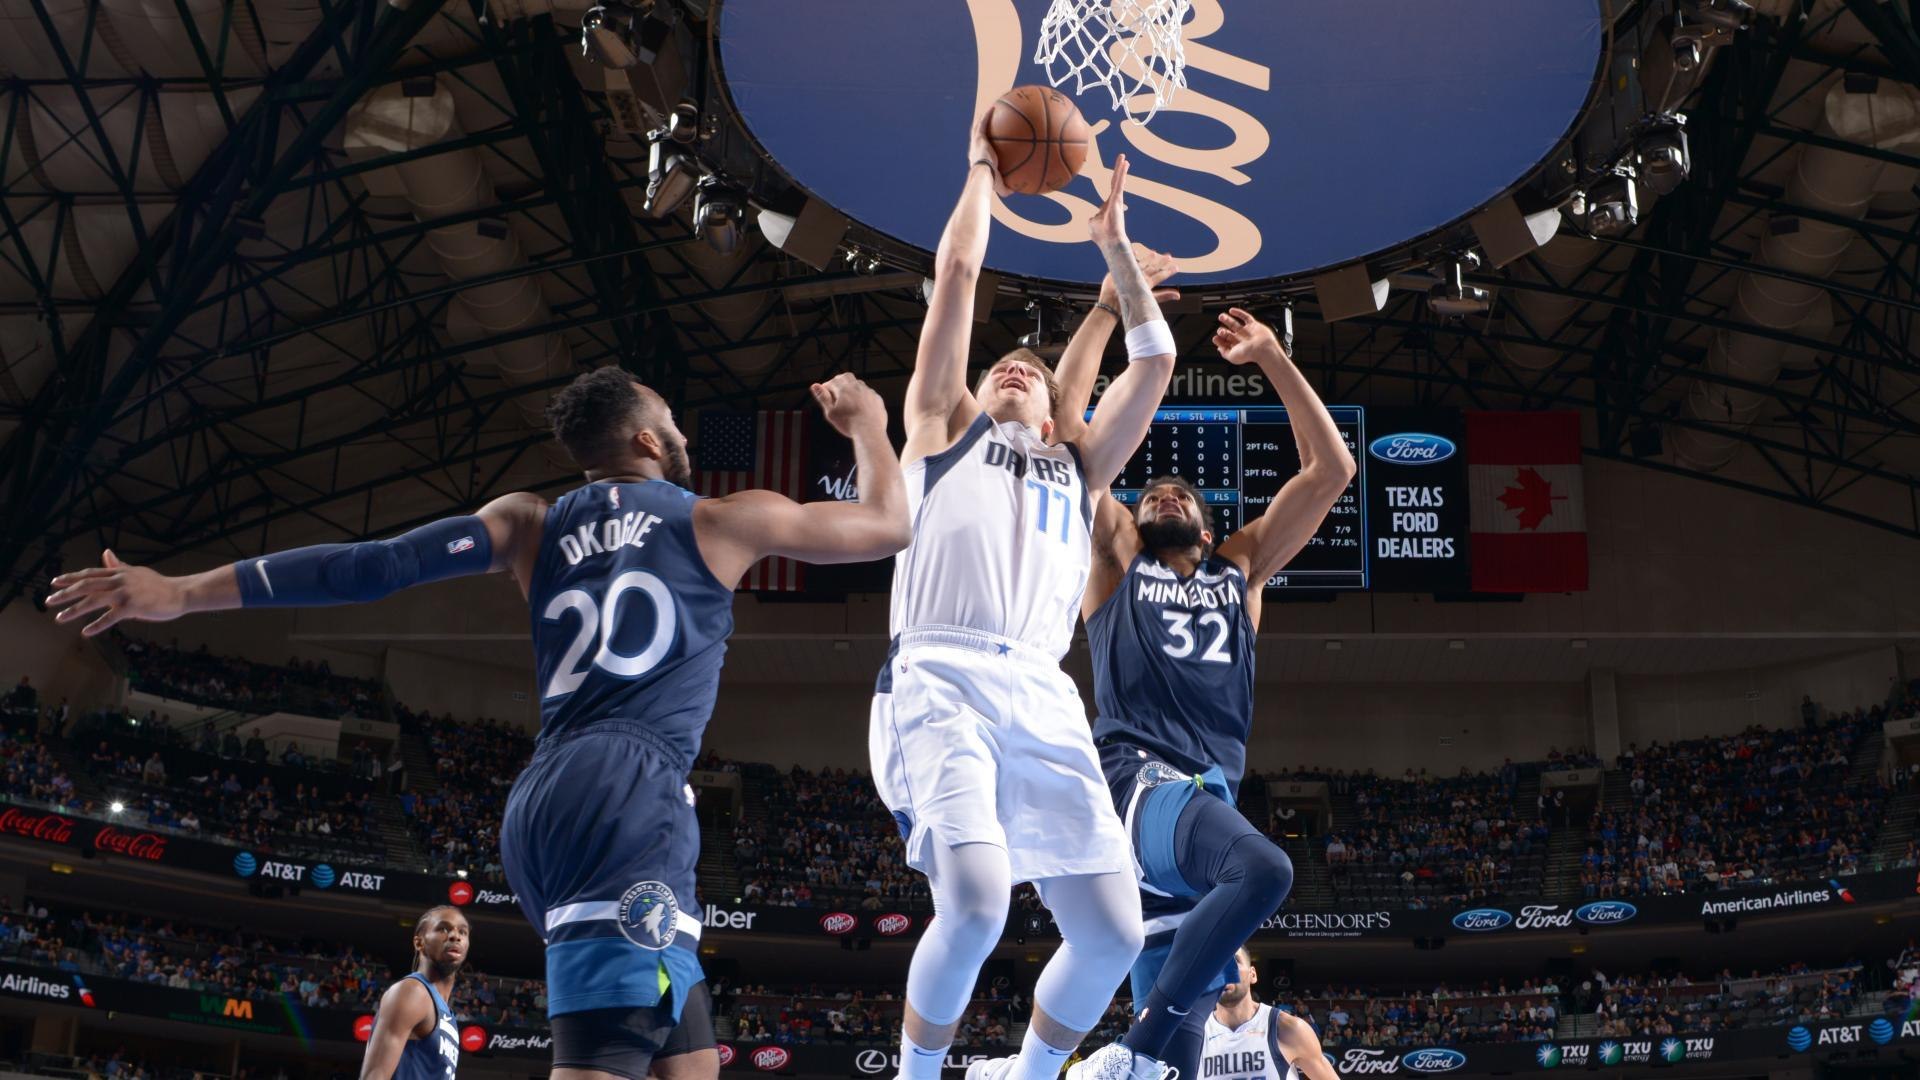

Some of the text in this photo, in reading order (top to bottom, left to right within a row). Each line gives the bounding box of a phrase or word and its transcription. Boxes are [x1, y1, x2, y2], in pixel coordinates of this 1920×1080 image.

[1166, 367, 1264, 397] rlines
[1163, 412, 1229, 421] AST STL FLS
[1171, 426, 1179, 435] 2
[1197, 426, 1204, 435] 0
[1224, 426, 1229, 435] 1
[1171, 440, 1179, 449] 0
[1197, 440, 1205, 449] 0
[1224, 440, 1229, 449] 1
[1246, 442, 1261, 451] 2PT
[1263, 442, 1279, 451] FGs
[1386, 437, 1439, 459] Ford
[1146, 453, 1229, 461] 2 4 0 0
[1146, 466, 1152, 474] 3
[1172, 466, 1179, 474] 0
[1198, 466, 1205, 474] 0
[1223, 466, 1229, 474] 3
[1244, 469, 1278, 477] 3PT FGs
[1119, 478, 1126, 486] 4
[1198, 478, 1205, 486] 0
[1223, 478, 1230, 486] 0
[1214, 493, 1230, 501] FLS
[1243, 495, 1265, 504] Total
[1385, 486, 1444, 507] TEXAS
[1026, 479, 1071, 545] 77
[1223, 508, 1230, 517] 0
[1330, 506, 1358, 514] 48.5%
[1392, 511, 1439, 533] FORD
[1335, 525, 1352, 534] 7/9
[1330, 538, 1358, 547] 77.8%
[1378, 537, 1455, 558] DEALERS
[543, 571, 678, 699] 20
[1162, 610, 1232, 663] 32
[260, 861, 385, 891] AT&T AT&T
[474, 889, 510, 904] Pizza
[1701, 889, 1830, 915] American Airlines
[1464, 904, 1625, 930] Ford Ford Ford
[2, 973, 70, 999] Airlines
[488, 1033, 553, 1049] Pizza Hut
[1818, 1025, 1863, 1045] AT&T
[1561, 1044, 1590, 1058] TXU
[1623, 1041, 1652, 1055] TXU
[1685, 1037, 1715, 1051] TXU
[1338, 1048, 1454, 1075] Ford Ford
[1561, 1057, 1588, 1066] energy
[1623, 1054, 1650, 1063] energy
[1685, 1050, 1713, 1060] energy
[1203, 1050, 1266, 1078] DALLAS
